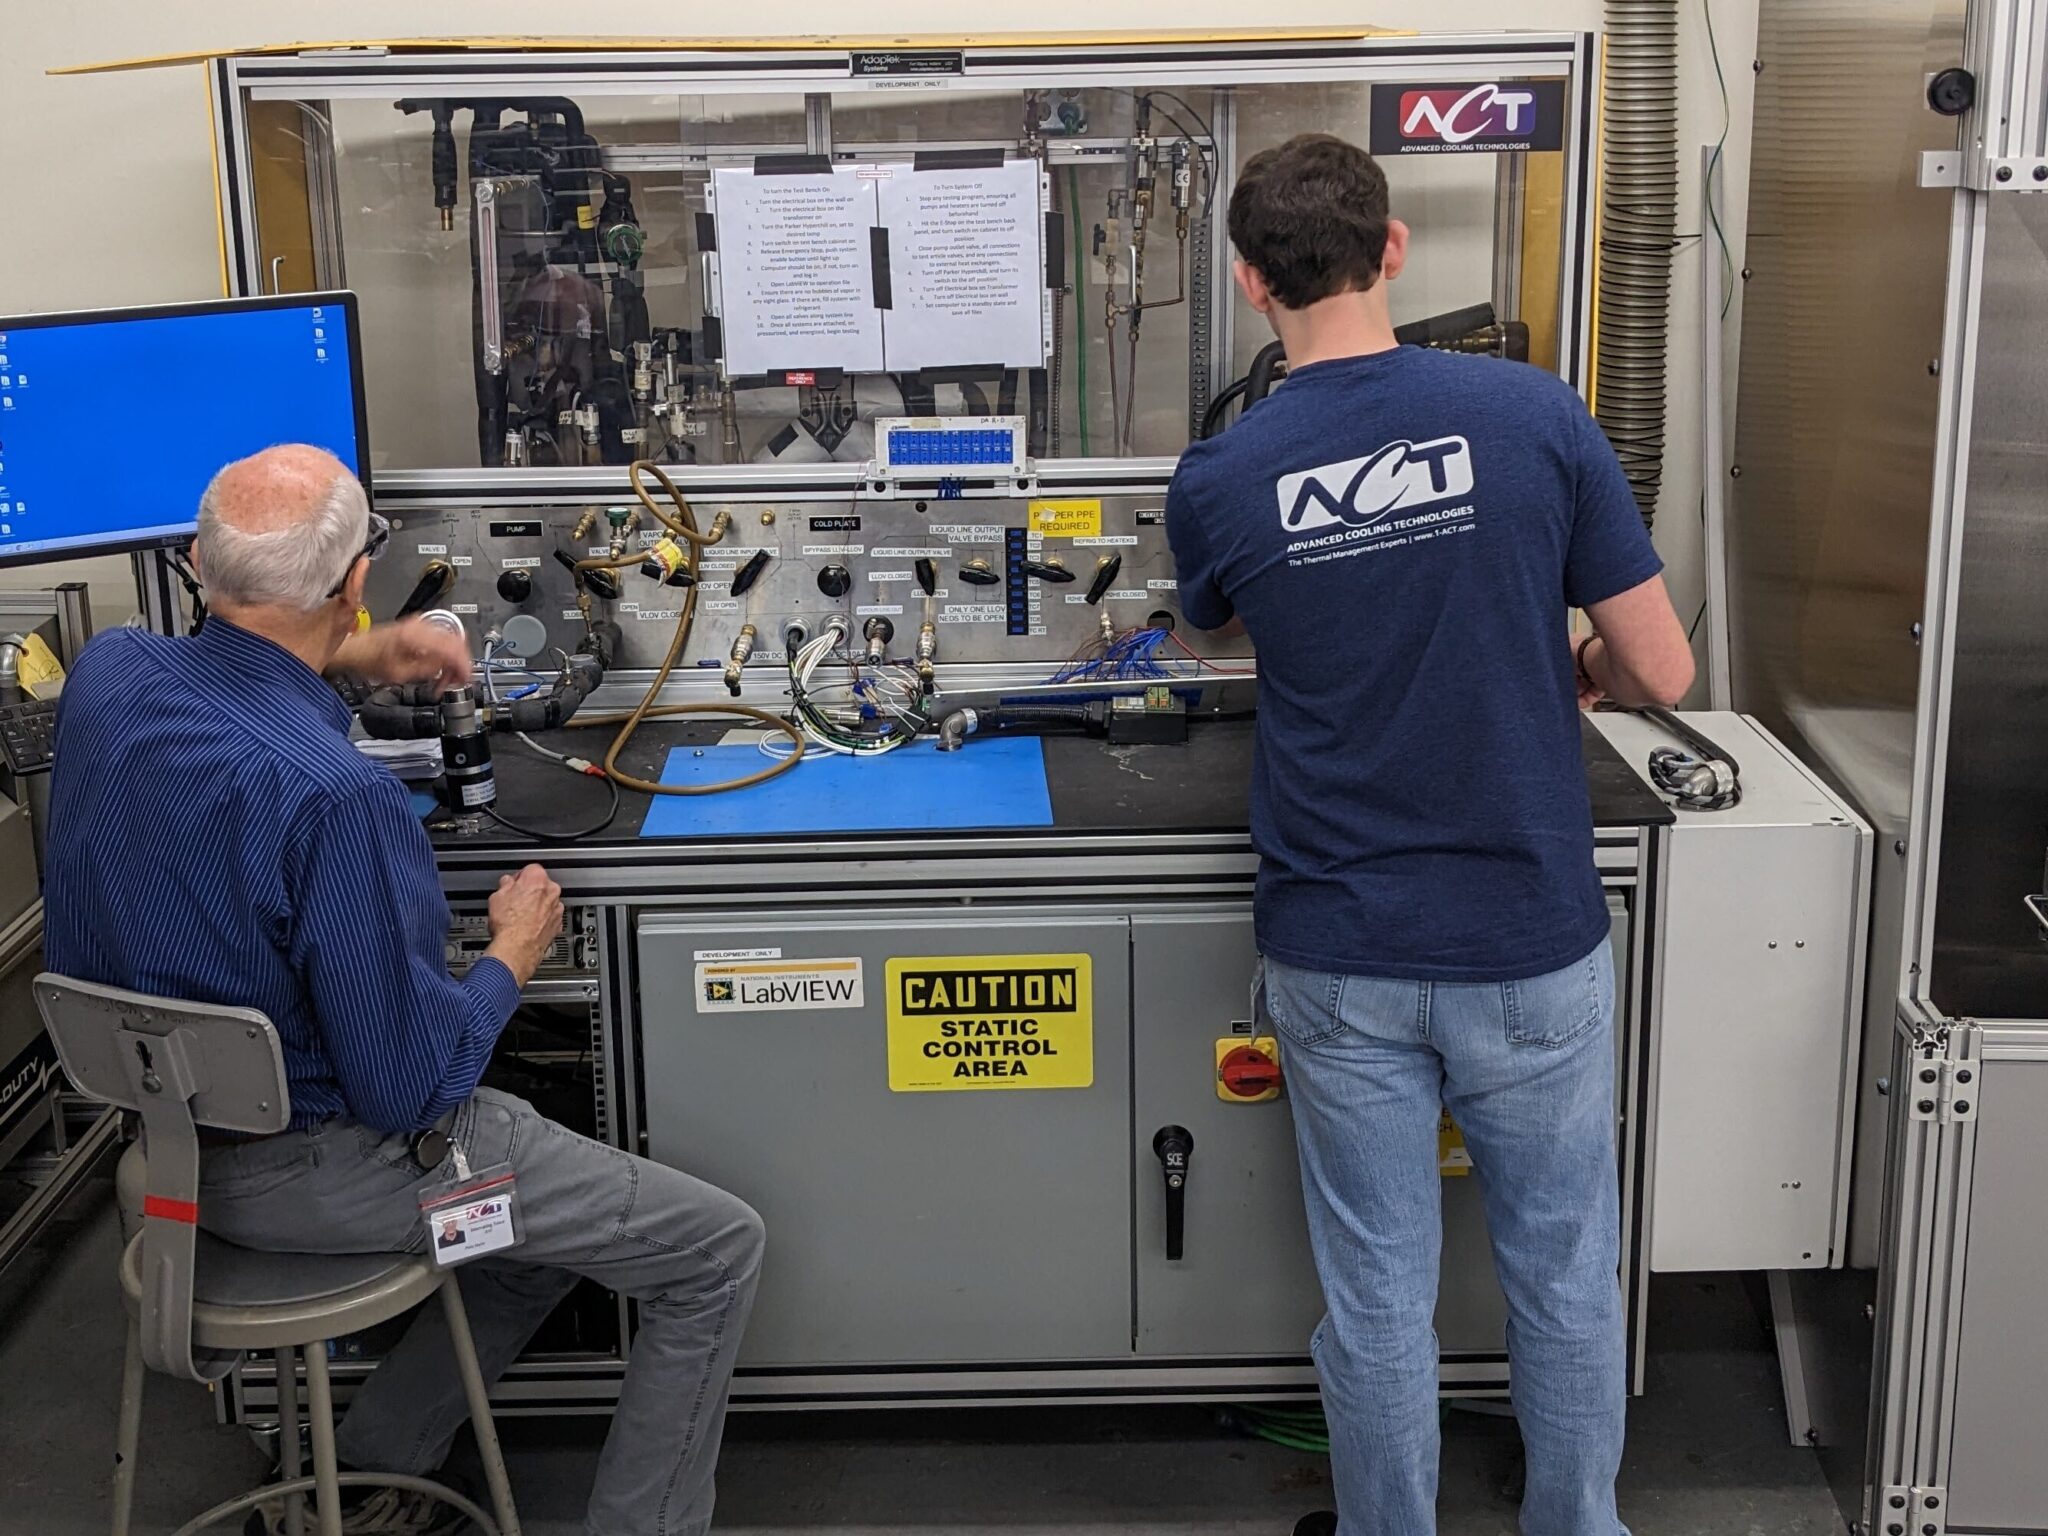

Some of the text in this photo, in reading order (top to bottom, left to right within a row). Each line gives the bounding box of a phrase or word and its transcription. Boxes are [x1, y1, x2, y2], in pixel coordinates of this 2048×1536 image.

[861, 55, 900, 65] AdapTek
[1403, 84, 1533, 142] ACT
[1401, 144, 1440, 152] ADVANCED
[1441, 143, 1474, 151] COOLING
[1288, 441, 1463, 526] ACT
[1034, 510, 1095, 519] PPER PPE
[931, 526, 957, 534] LIQUID
[1039, 523, 1090, 531] REQUIRED
[1287, 505, 1474, 553] ADVANCED COOLING TECHNOLOGIES
[972, 534, 1003, 542] BYPASS
[1288, 523, 1475, 568] The Thermal Management Experts www.1-ACT.com
[741, 979, 855, 1004] LabVIEW
[905, 974, 1073, 1009] CAUTION
[940, 1018, 1039, 1037] STATIC
[922, 1039, 1058, 1058] CONTROL
[2, 1057, 38, 1100] DUTY
[953, 1060, 1029, 1078] AREA
[1167, 1153, 1183, 1166] SCE
